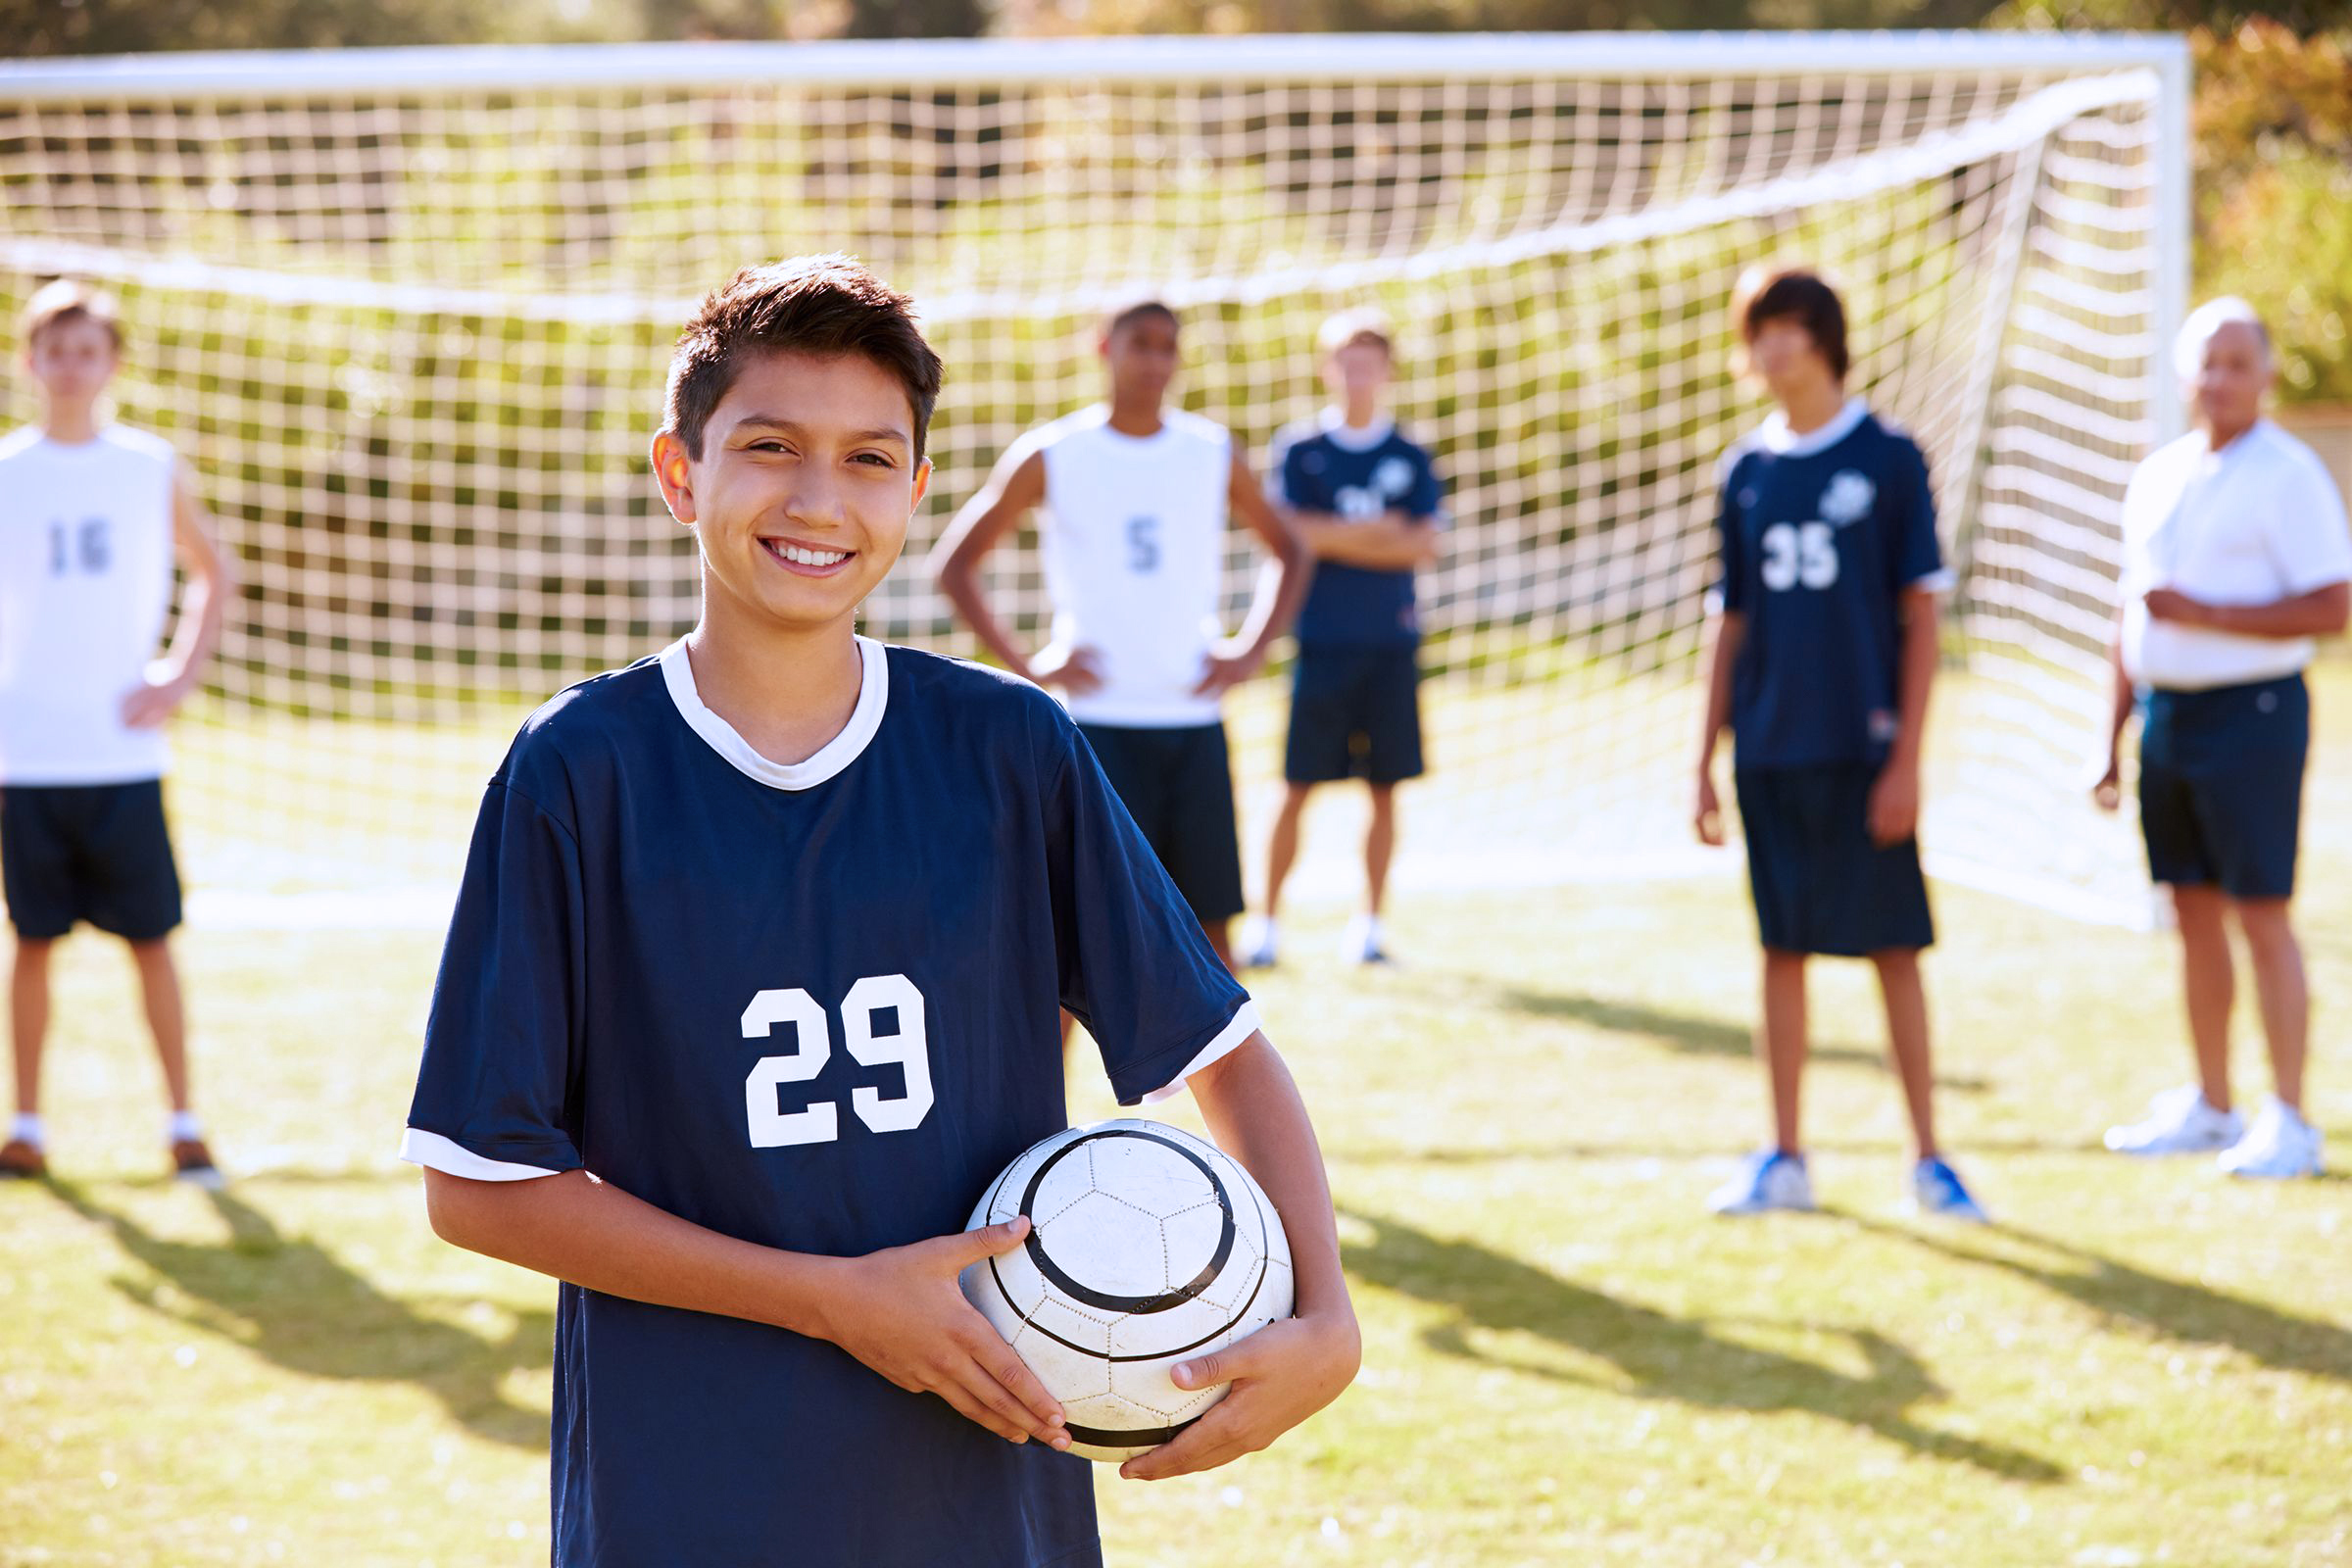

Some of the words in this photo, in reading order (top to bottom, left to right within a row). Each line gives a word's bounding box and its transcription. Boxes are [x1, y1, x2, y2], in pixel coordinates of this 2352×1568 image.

[48, 519, 113, 576] 16
[1126, 514, 1160, 572] 5
[1762, 521, 1838, 591] 35
[740, 973, 935, 1149] 29
